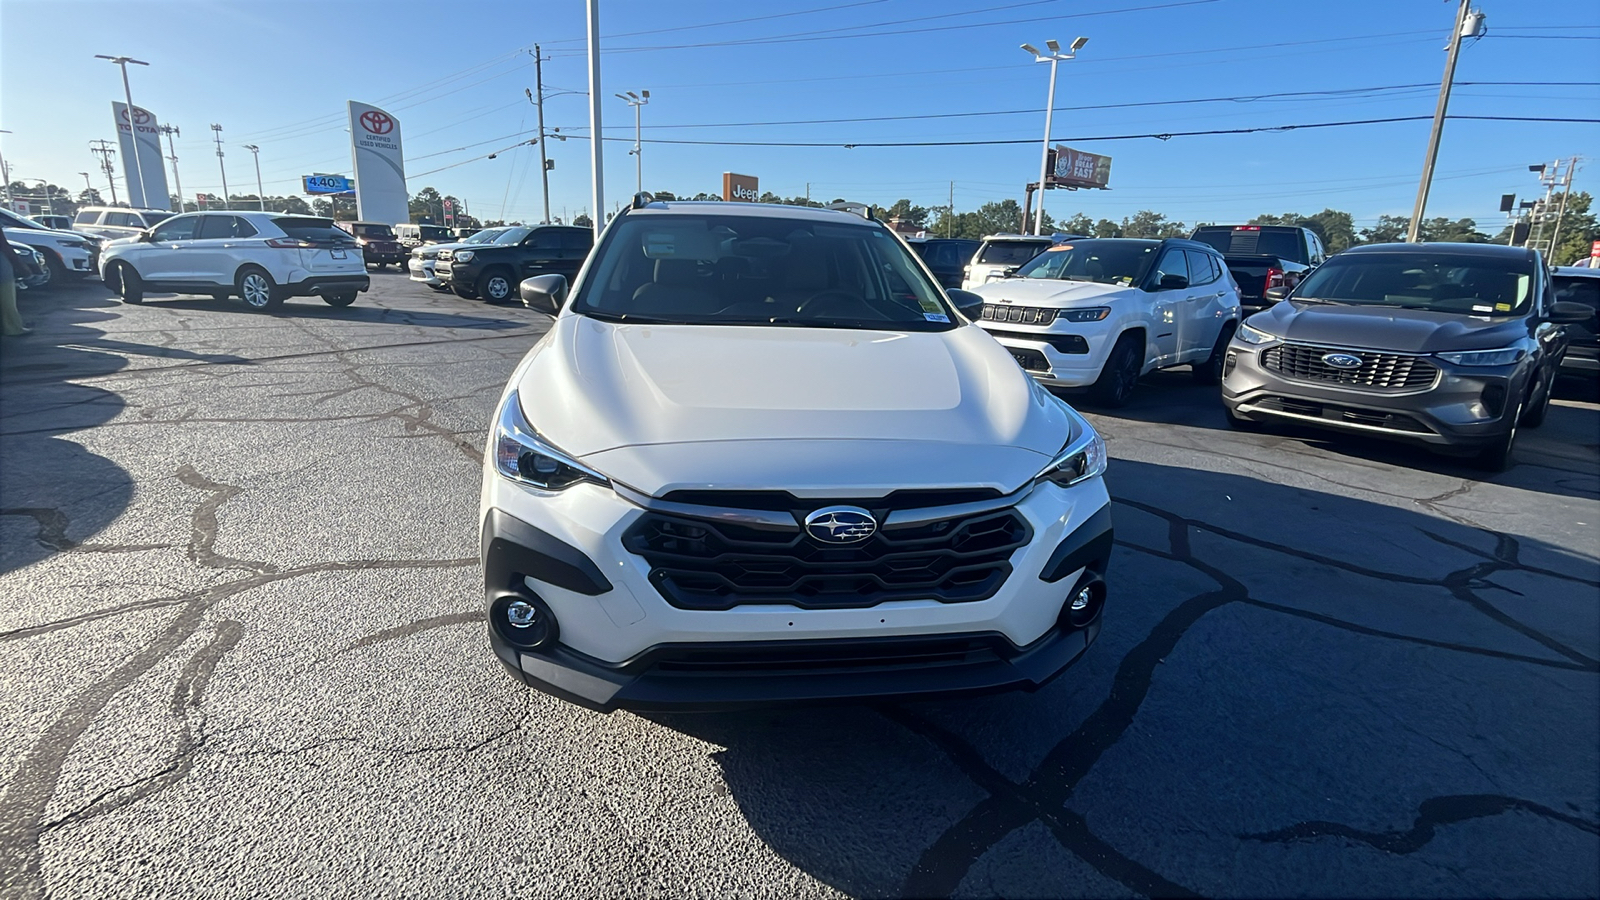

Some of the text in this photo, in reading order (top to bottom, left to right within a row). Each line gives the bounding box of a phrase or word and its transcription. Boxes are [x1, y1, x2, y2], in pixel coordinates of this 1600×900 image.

[118, 123, 158, 134] TOOTA
[366, 134, 391, 143] CERTIFIED
[375, 142, 398, 150] VEHICLES
[1075, 159, 1094, 169] BREAK
[1073, 167, 1093, 179] FAST
[732, 184, 758, 202] Jeep
